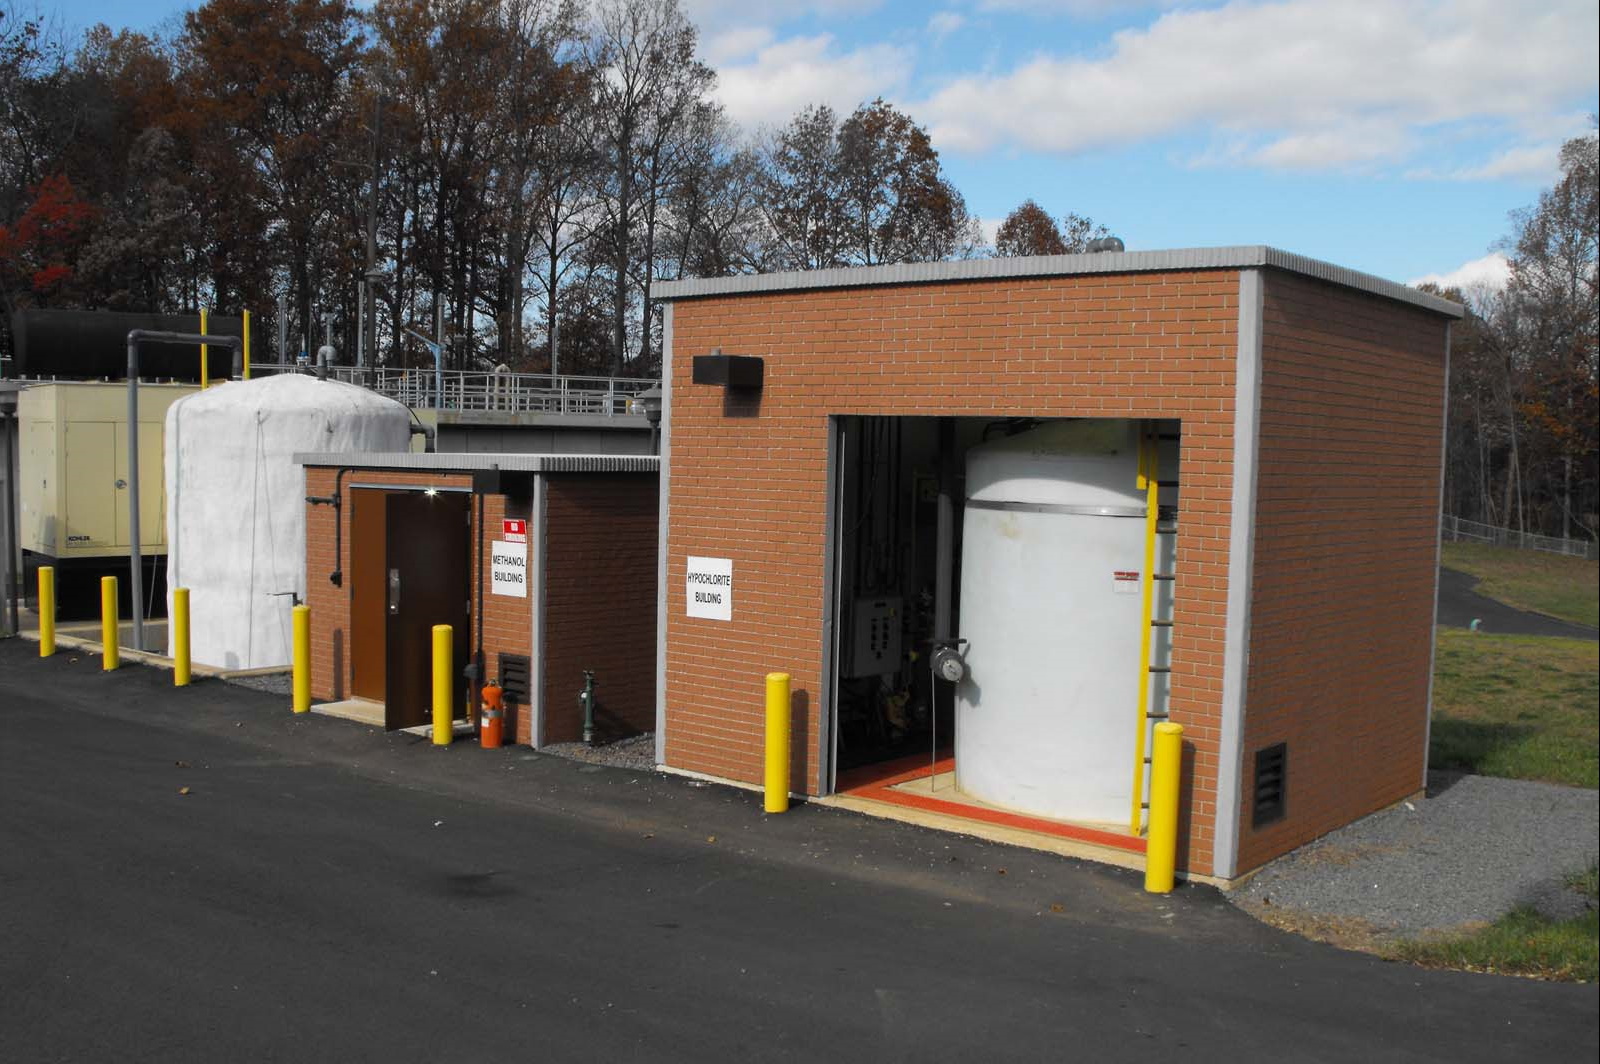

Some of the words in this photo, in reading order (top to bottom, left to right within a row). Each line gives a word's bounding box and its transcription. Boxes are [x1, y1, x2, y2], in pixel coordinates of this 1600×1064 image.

[493, 554, 525, 567] METHANOL
[494, 571, 523, 584] BUILDING
[687, 573, 731, 586] HYPOCHLORITE
[695, 591, 722, 605] BUILDING
